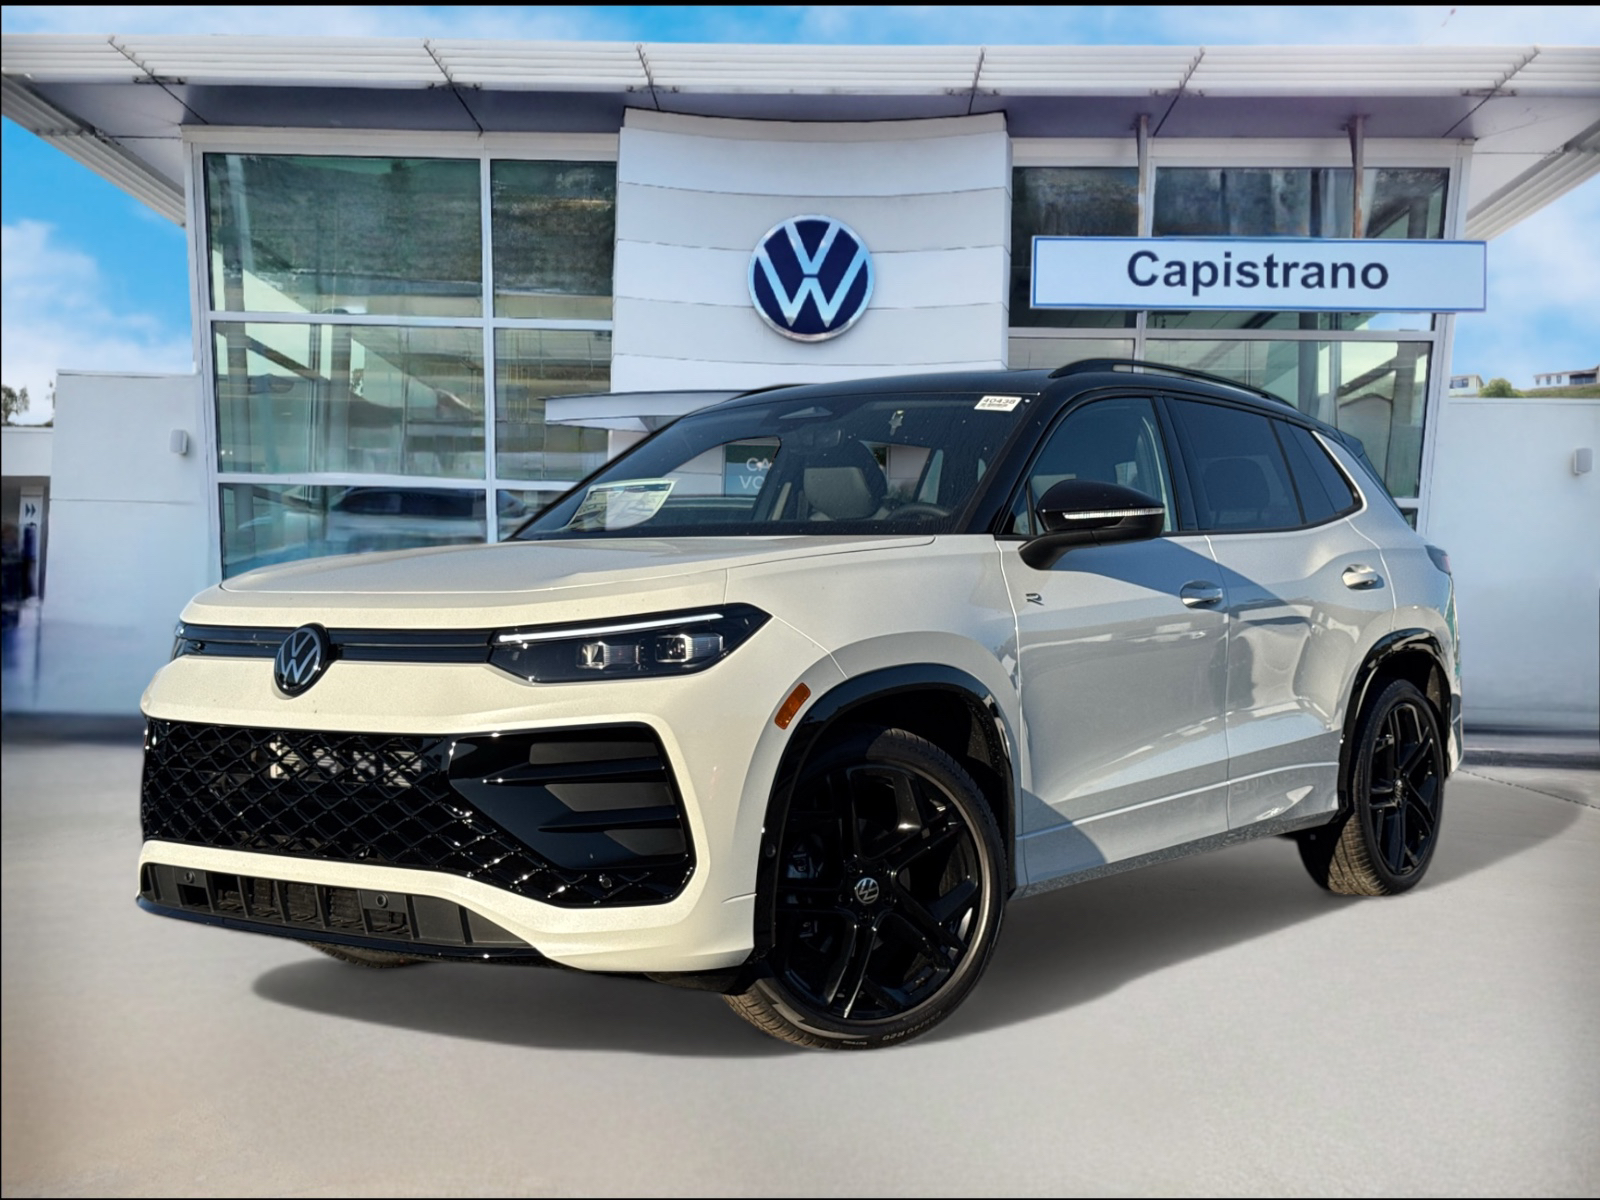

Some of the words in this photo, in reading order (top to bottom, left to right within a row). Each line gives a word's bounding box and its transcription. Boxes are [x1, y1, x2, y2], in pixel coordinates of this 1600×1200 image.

[753, 218, 869, 329] VW
[1127, 250, 1389, 296] Capistrano
[1025, 593, 1045, 606] R
[279, 629, 320, 685] VW
